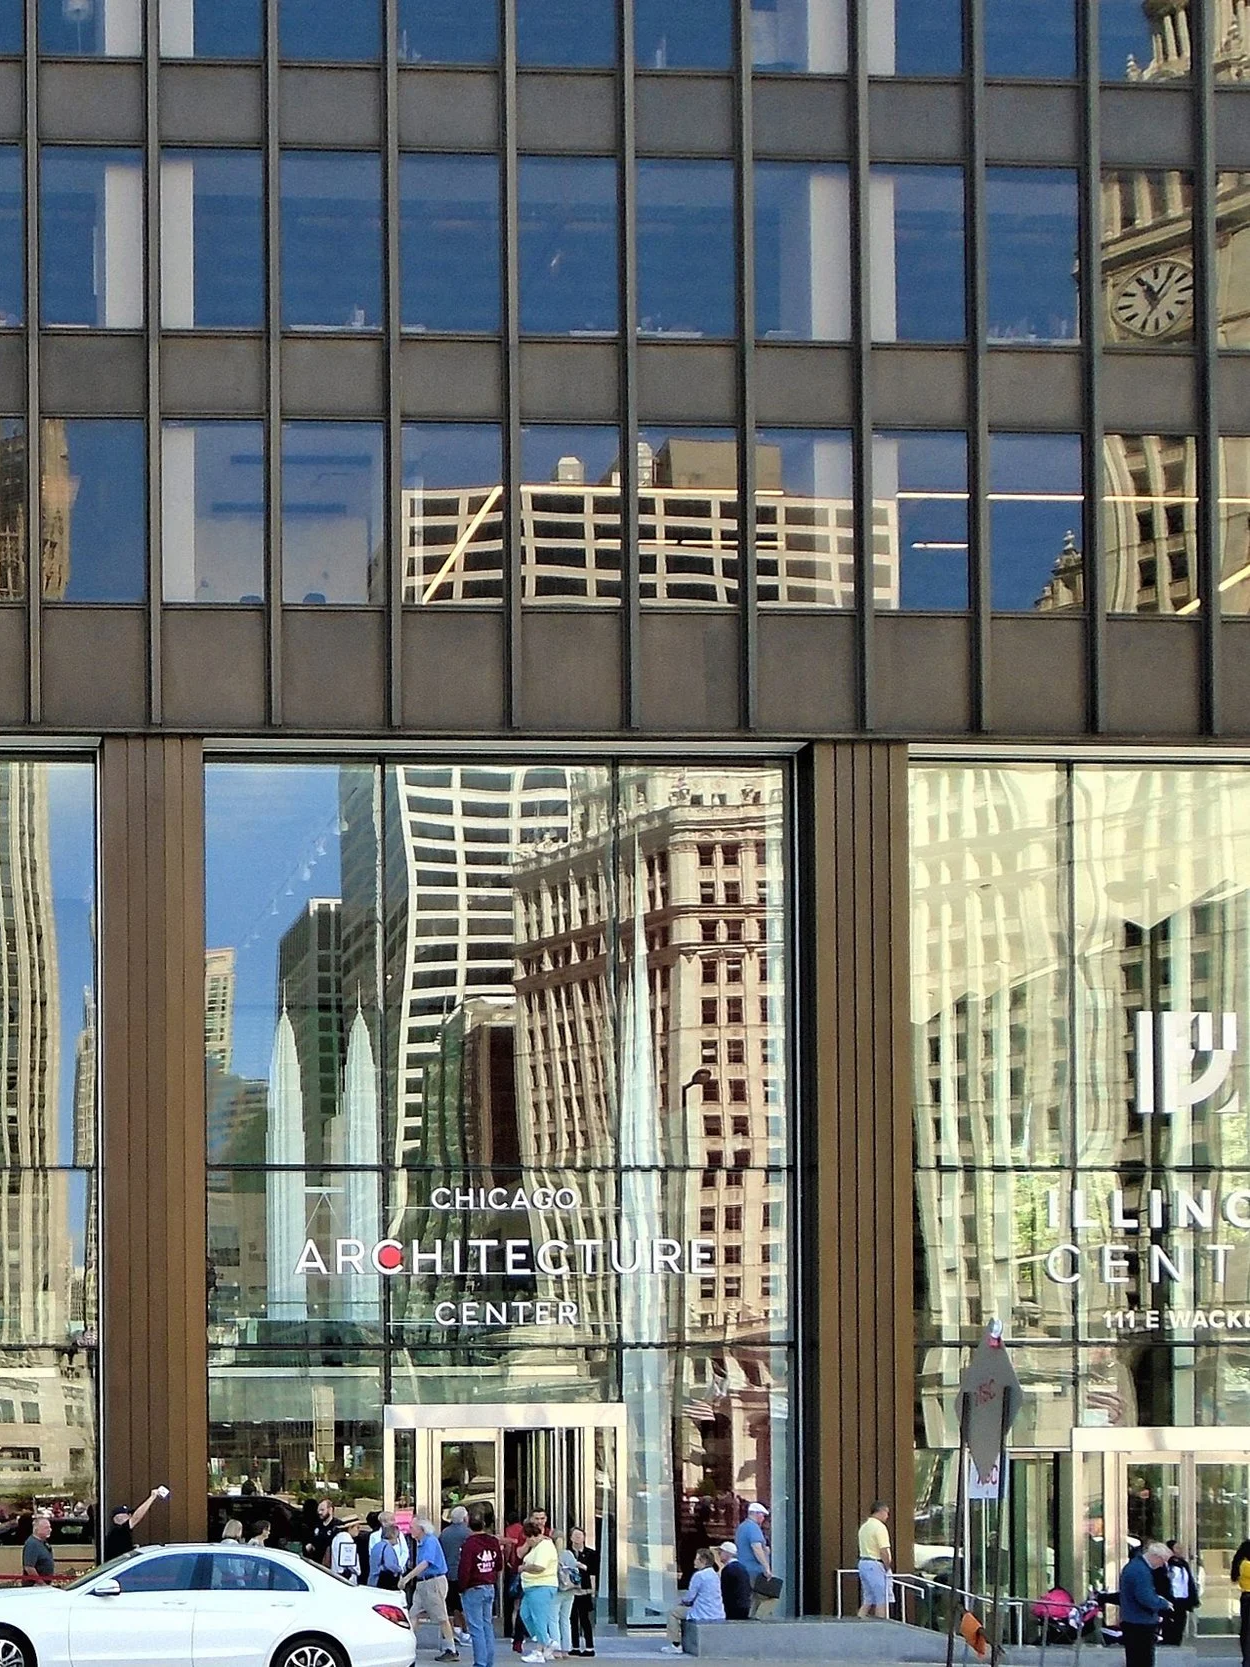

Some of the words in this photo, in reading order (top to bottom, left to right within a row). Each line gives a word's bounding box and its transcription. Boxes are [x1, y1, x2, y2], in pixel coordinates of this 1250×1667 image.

[430, 1187, 578, 1210] CHICAGO
[294, 1238, 716, 1275] ARCHITECTURE
[1047, 1244, 1236, 1284] CENT
[435, 1301, 578, 1326] CENTER
[1102, 1310, 1136, 1329] 111
[1146, 1310, 1160, 1329] E
